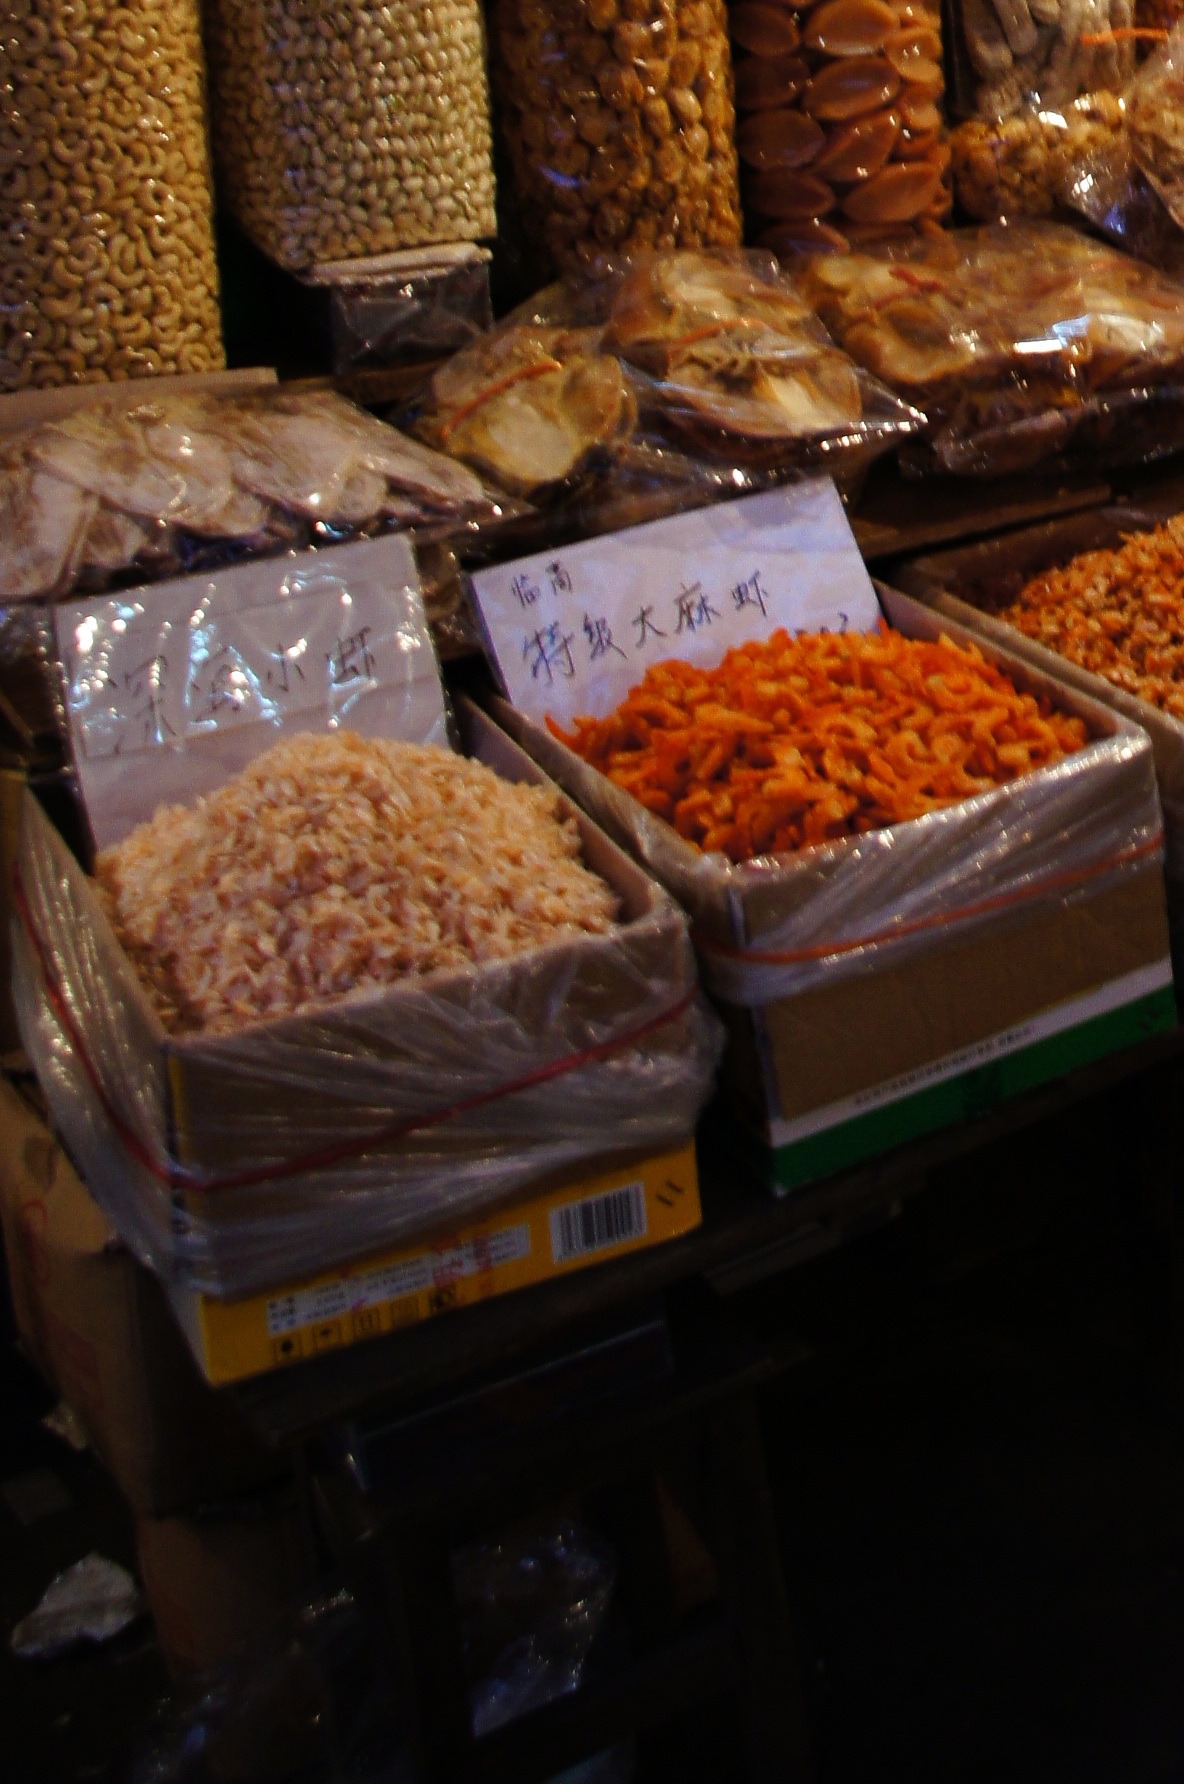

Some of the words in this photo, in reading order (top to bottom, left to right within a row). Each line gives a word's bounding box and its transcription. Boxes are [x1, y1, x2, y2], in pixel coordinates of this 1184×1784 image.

[522, 569, 768, 686] 特级大麻虾
